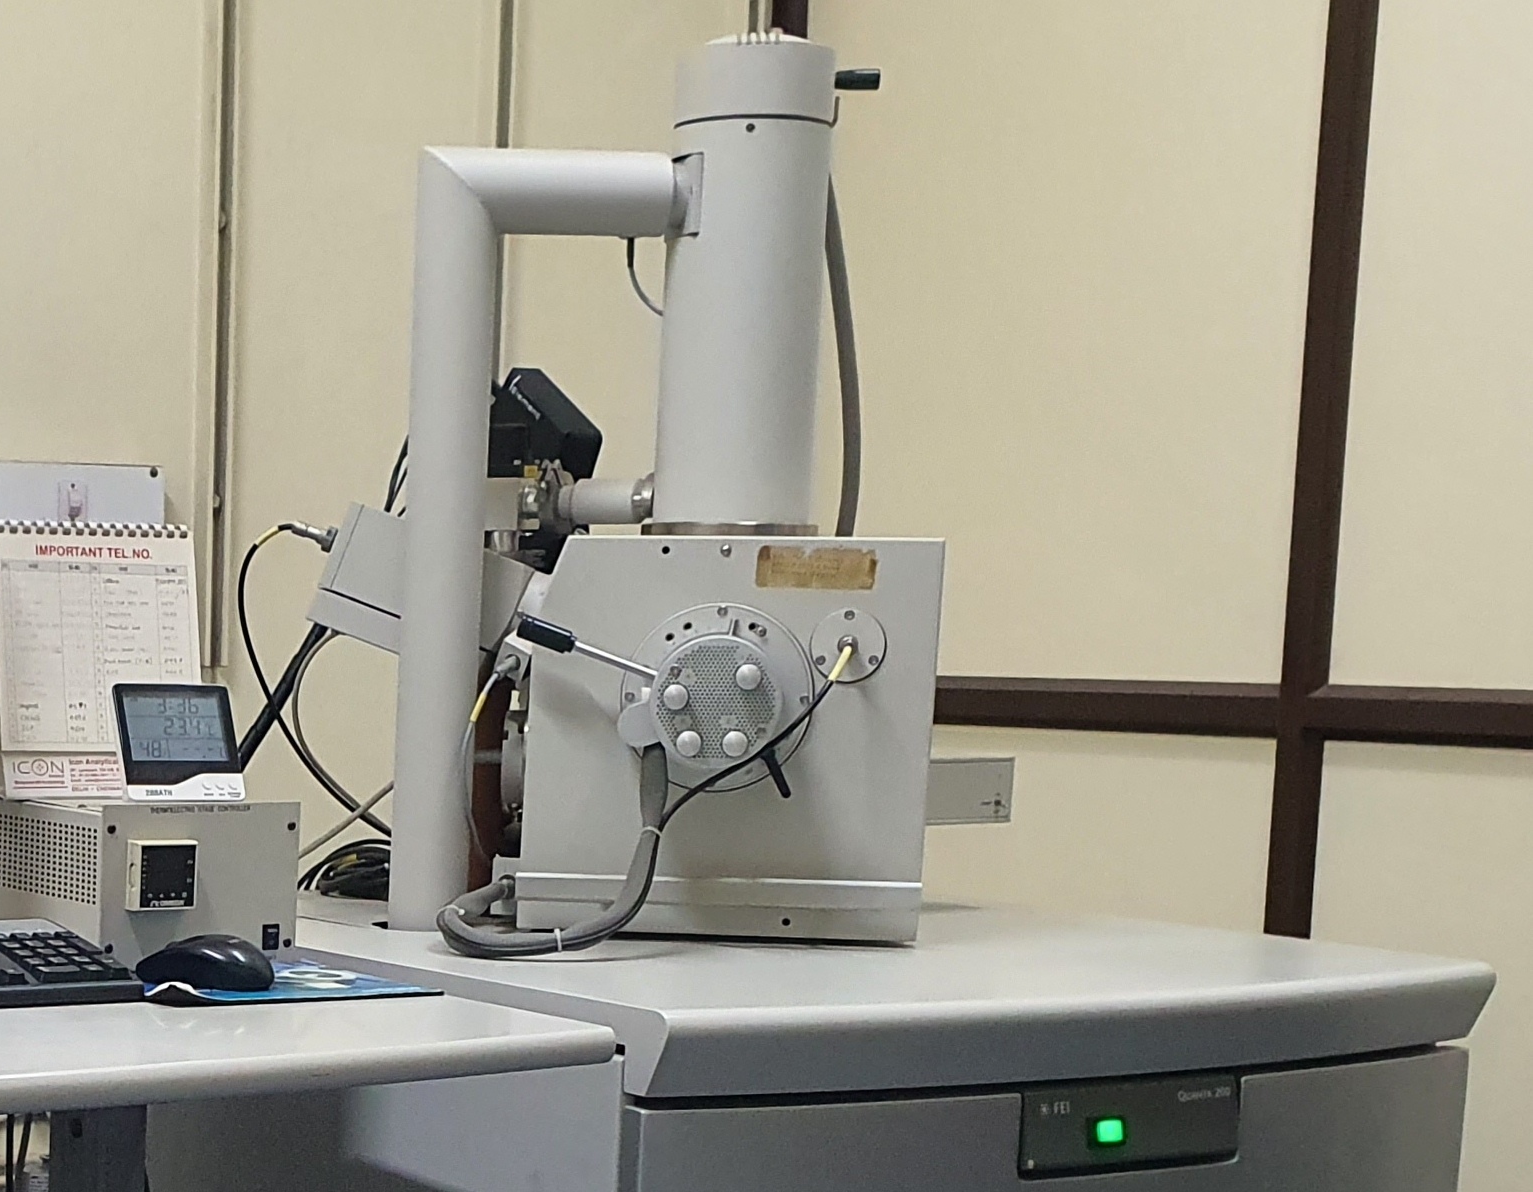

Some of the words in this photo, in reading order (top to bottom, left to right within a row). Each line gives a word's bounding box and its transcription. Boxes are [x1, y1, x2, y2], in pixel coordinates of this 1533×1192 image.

[35, 545, 103, 558] IMPORTANT
[157, 697, 200, 714] 3:36
[12, 758, 65, 776] ICON
[1053, 1101, 1070, 1114] FEI
